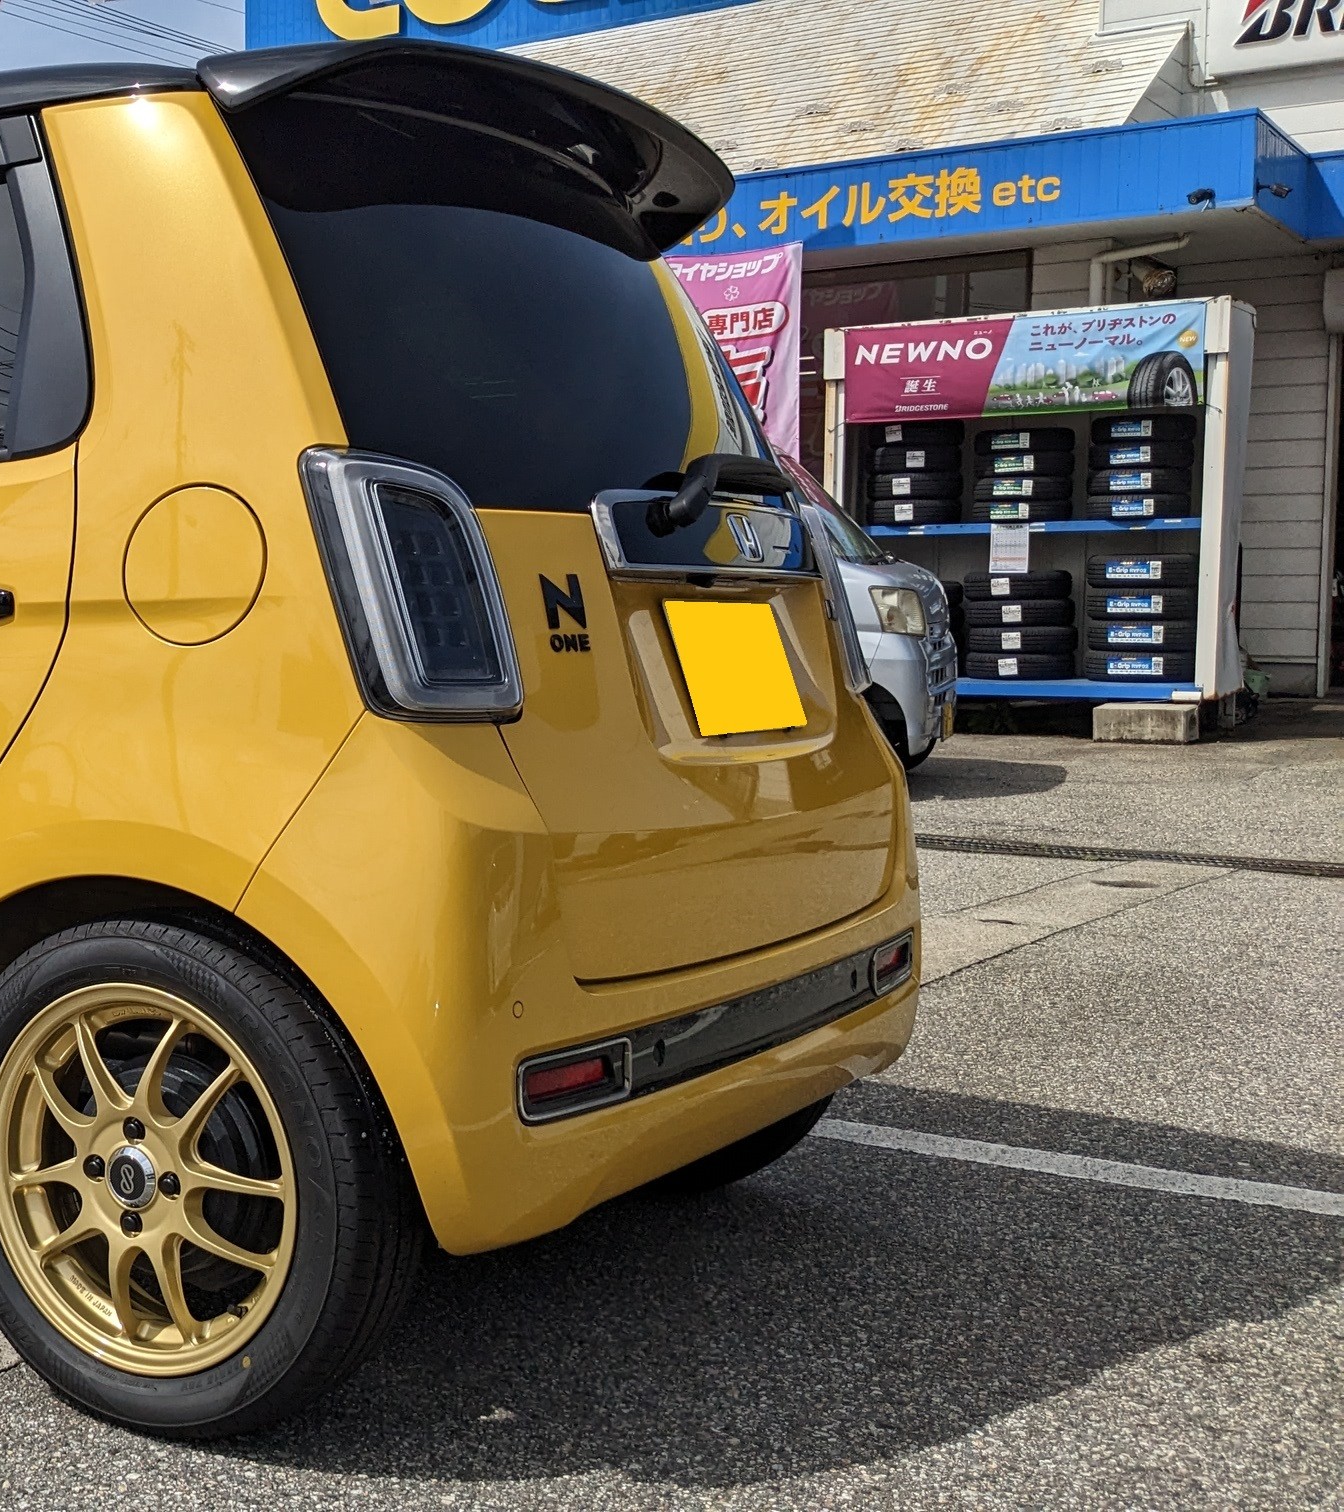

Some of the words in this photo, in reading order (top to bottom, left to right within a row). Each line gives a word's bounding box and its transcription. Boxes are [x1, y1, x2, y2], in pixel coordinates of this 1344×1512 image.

[1234, 0, 1344, 45] BR
[680, 167, 982, 245] り、オイル交換
[992, 174, 1061, 206] etc
[708, 308, 774, 336] 専門店
[1030, 313, 1176, 337] これが、ブリヂストンの
[1029, 333, 1143, 351] ニューノーマル。
[1179, 335, 1197, 343] NEW
[854, 337, 993, 365] NEWNO
[904, 378, 937, 393] 誕生
[895, 403, 949, 413] BRIDGESTONE
[1108, 566, 1129, 574] E-Grip
[538, 573, 587, 629] N
[550, 633, 591, 652] ONE
[1110, 630, 1131, 638] E-Grip
[1109, 662, 1131, 670] E-Grip
[84, 1292, 94, 1303] IN
[92, 1301, 113, 1317] JAPAN
